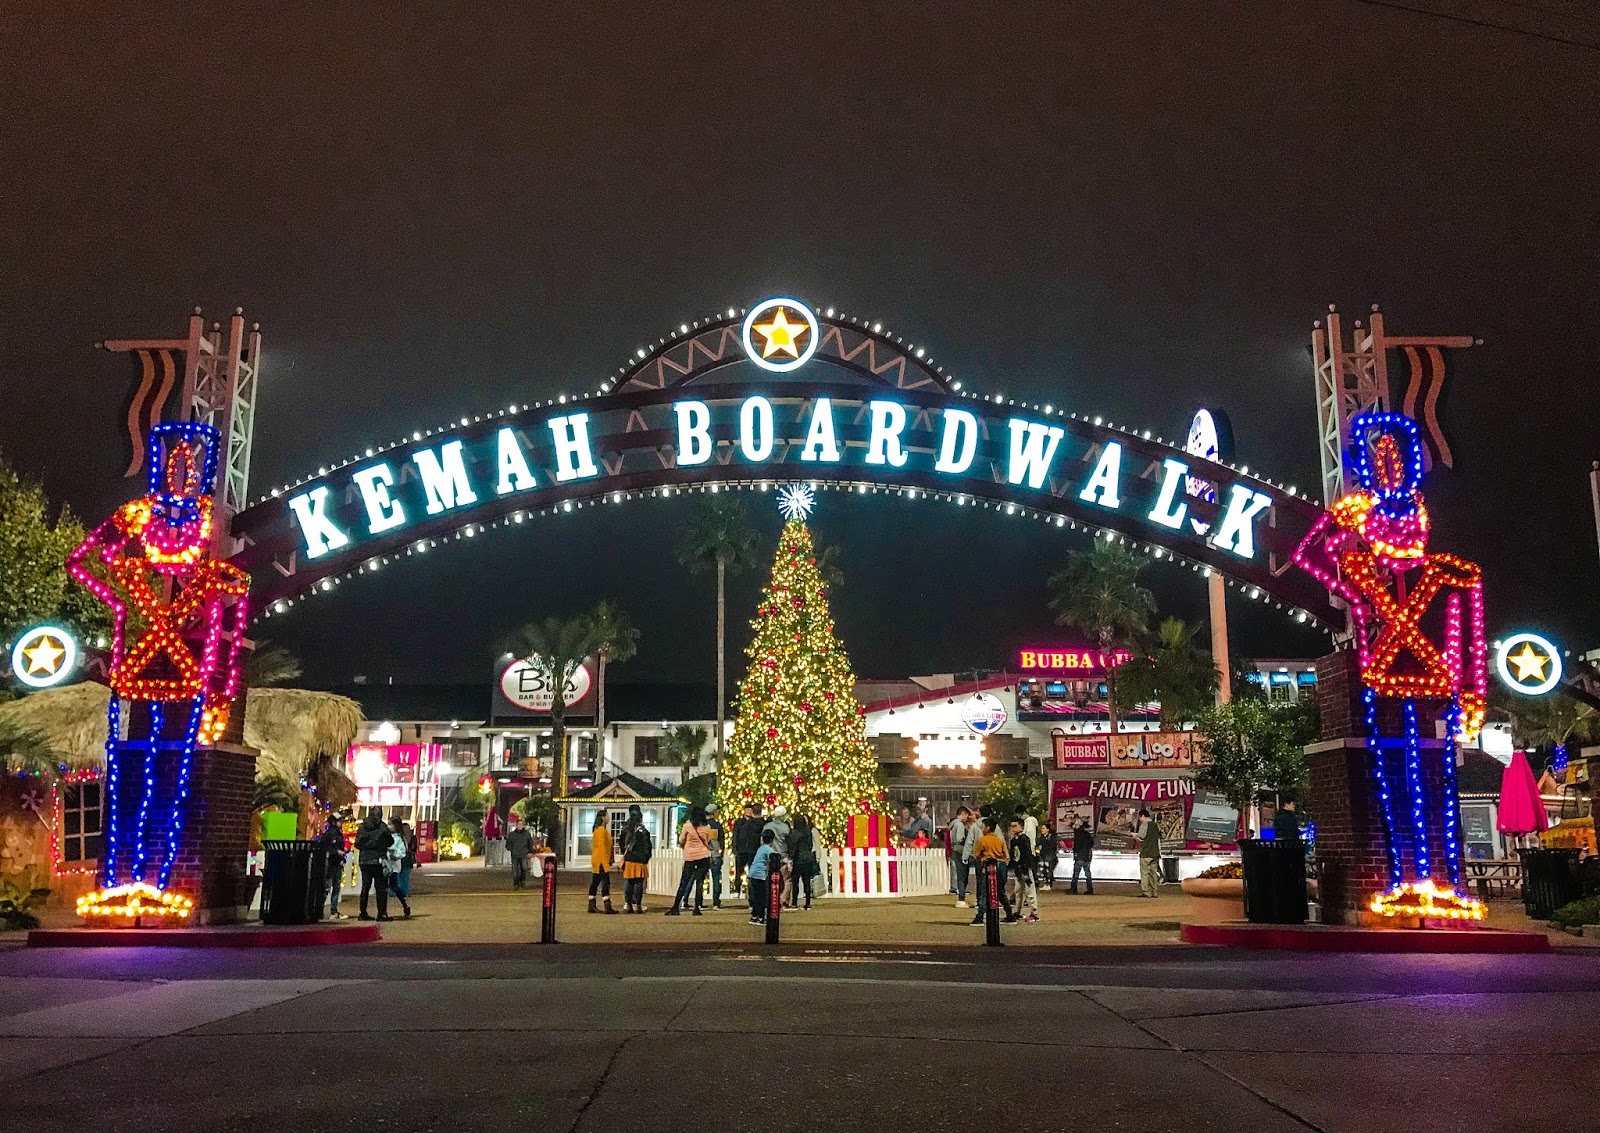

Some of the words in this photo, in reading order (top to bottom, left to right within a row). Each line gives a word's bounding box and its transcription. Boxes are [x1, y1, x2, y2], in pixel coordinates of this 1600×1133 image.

[289, 413, 598, 559] KEMAH
[674, 396, 1272, 558] BOARDWALK
[1021, 651, 1094, 668] BUBBA
[1065, 744, 1107, 758] BUBBA'S
[1088, 780, 1151, 800] FAMILY
[1157, 779, 1197, 798] FUN!
